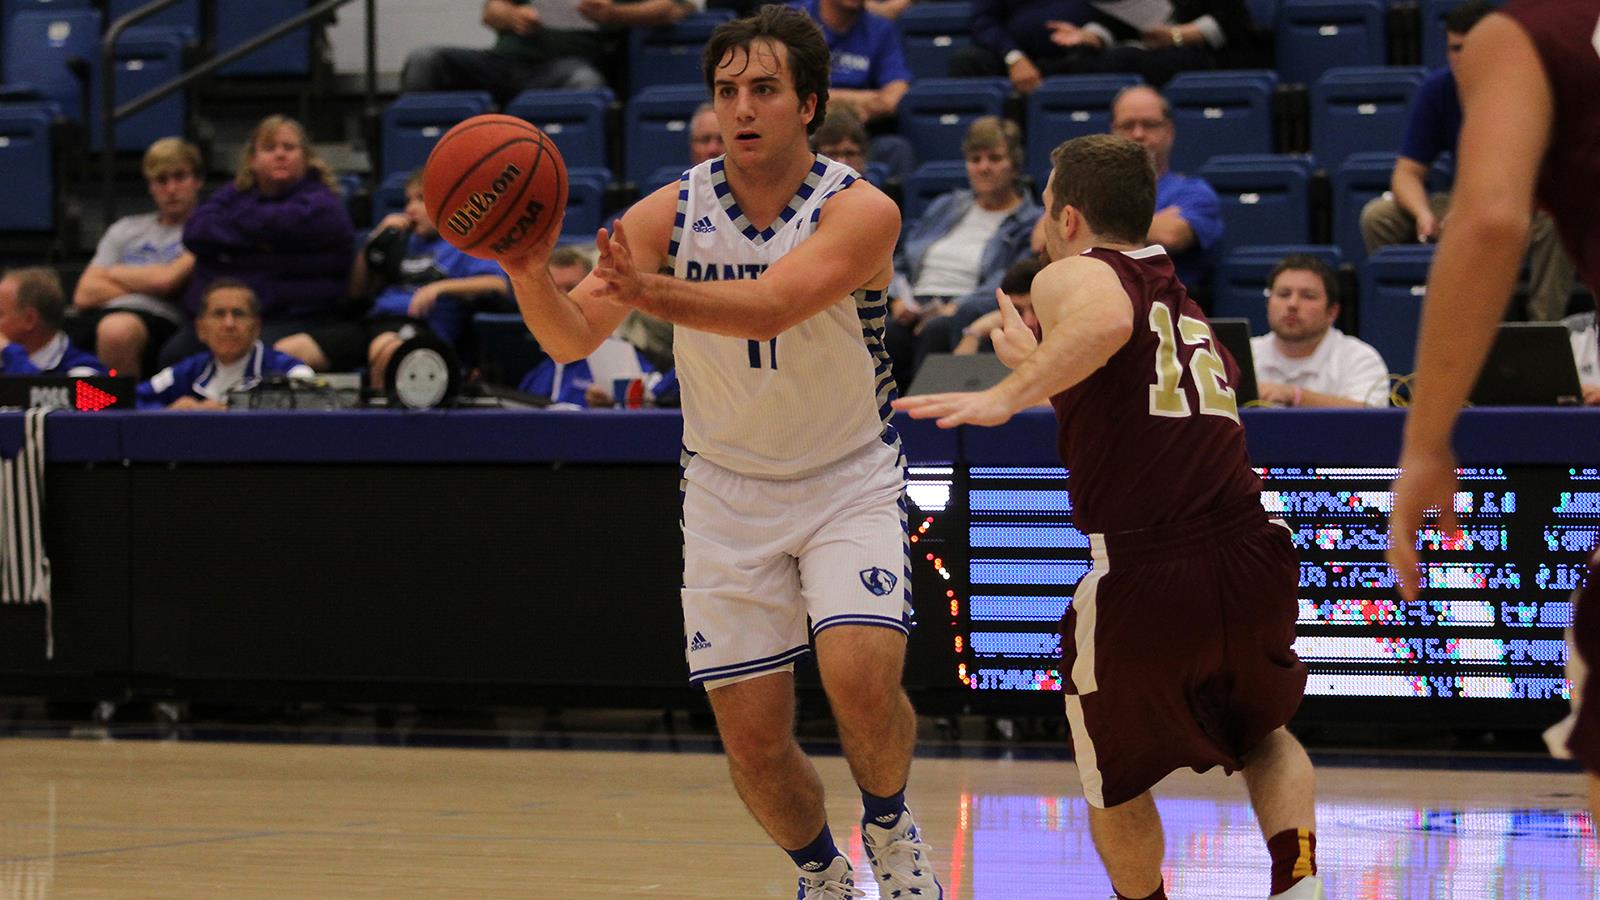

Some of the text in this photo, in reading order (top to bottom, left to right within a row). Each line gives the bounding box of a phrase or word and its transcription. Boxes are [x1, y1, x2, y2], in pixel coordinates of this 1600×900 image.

[448, 162, 521, 237] Wilson
[490, 200, 544, 255] NCAA
[686, 260, 769, 282] PANT
[1148, 301, 1240, 426] 12
